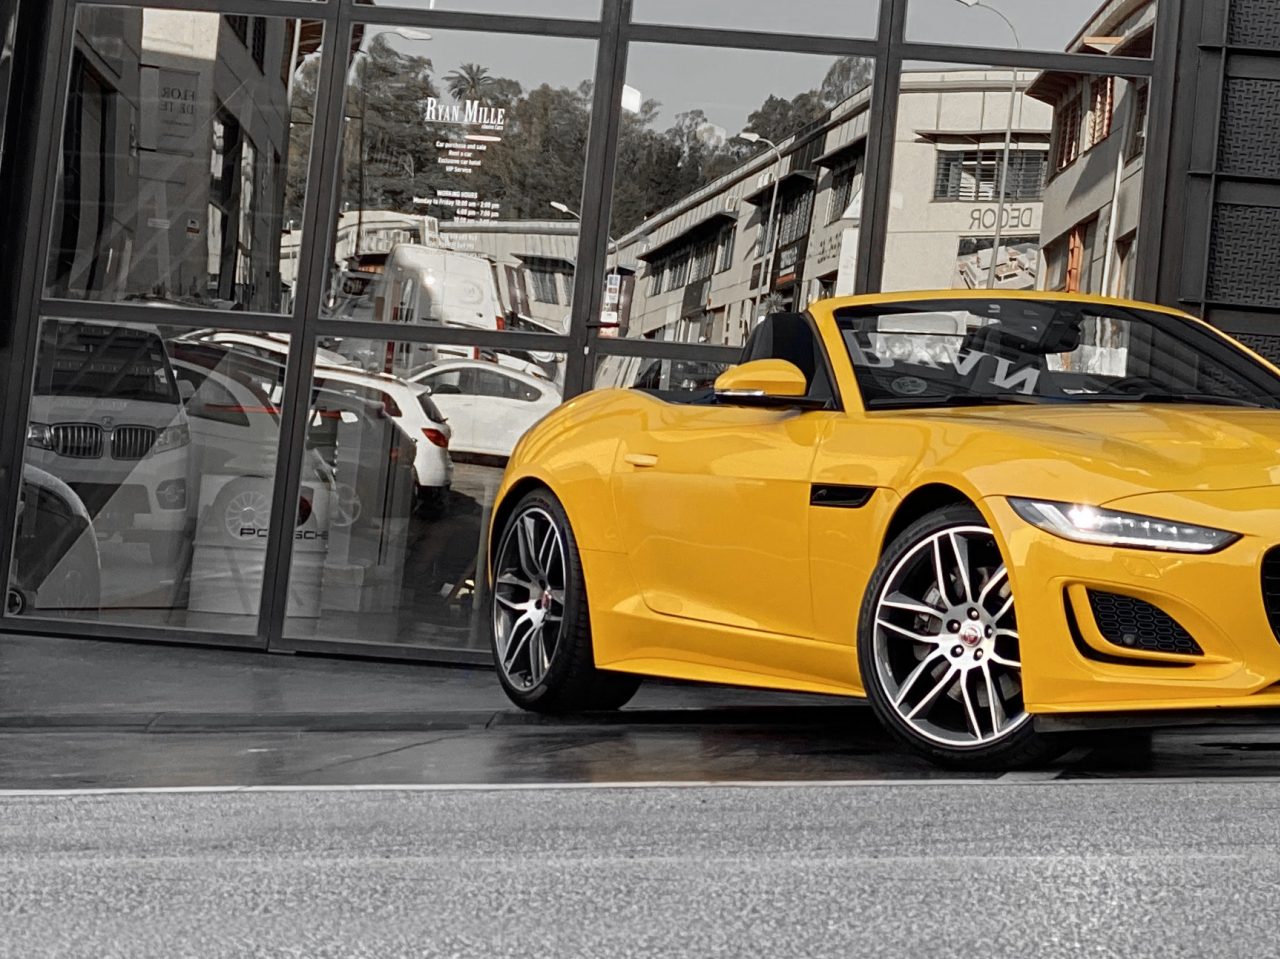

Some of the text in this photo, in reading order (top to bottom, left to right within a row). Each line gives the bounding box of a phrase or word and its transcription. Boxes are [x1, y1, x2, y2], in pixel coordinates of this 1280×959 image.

[425, 97, 505, 125] RYAN MILLE
[240, 527, 329, 540] POSCHE
